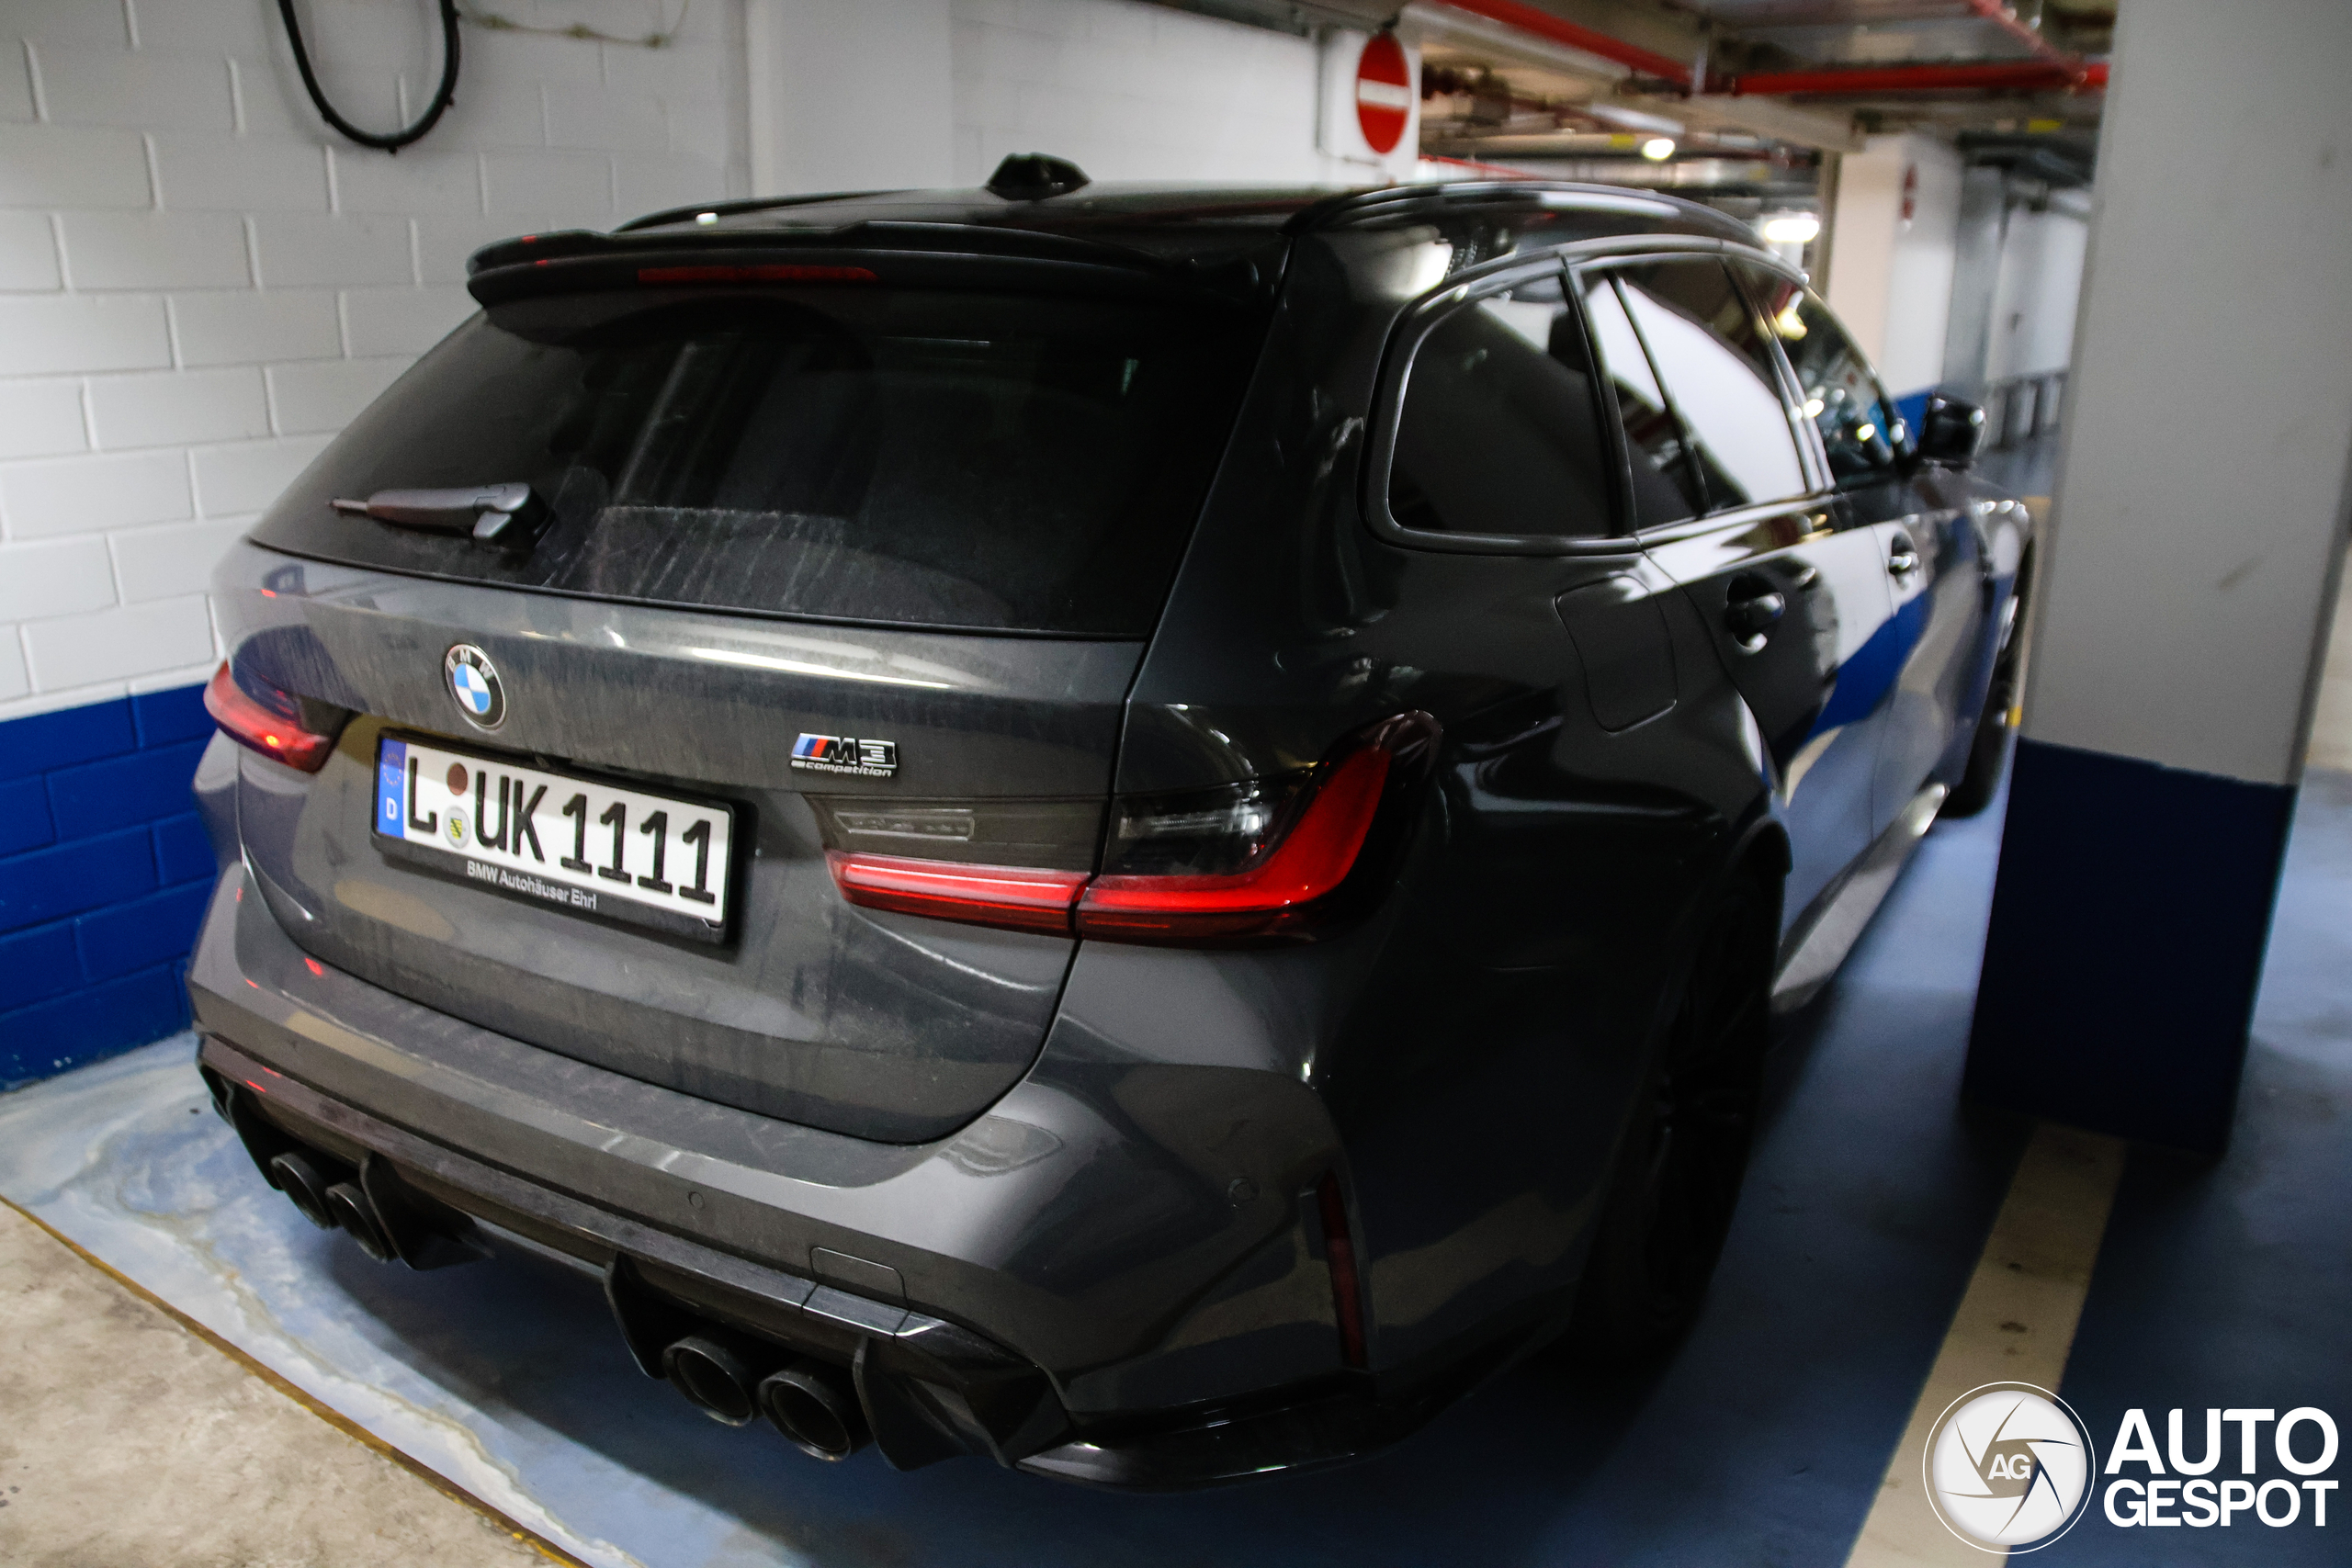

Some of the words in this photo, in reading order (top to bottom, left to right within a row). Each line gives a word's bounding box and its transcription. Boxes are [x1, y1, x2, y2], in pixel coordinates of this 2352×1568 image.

[447, 648, 494, 680] BMW
[806, 761, 892, 777] competition
[386, 797, 398, 820] D
[408, 757, 437, 833] L
[475, 771, 548, 863] UK
[560, 794, 716, 905] 1111
[467, 860, 499, 884] BMW
[499, 870, 570, 903] Autohäuser
[571, 888, 597, 910] Ehrl
